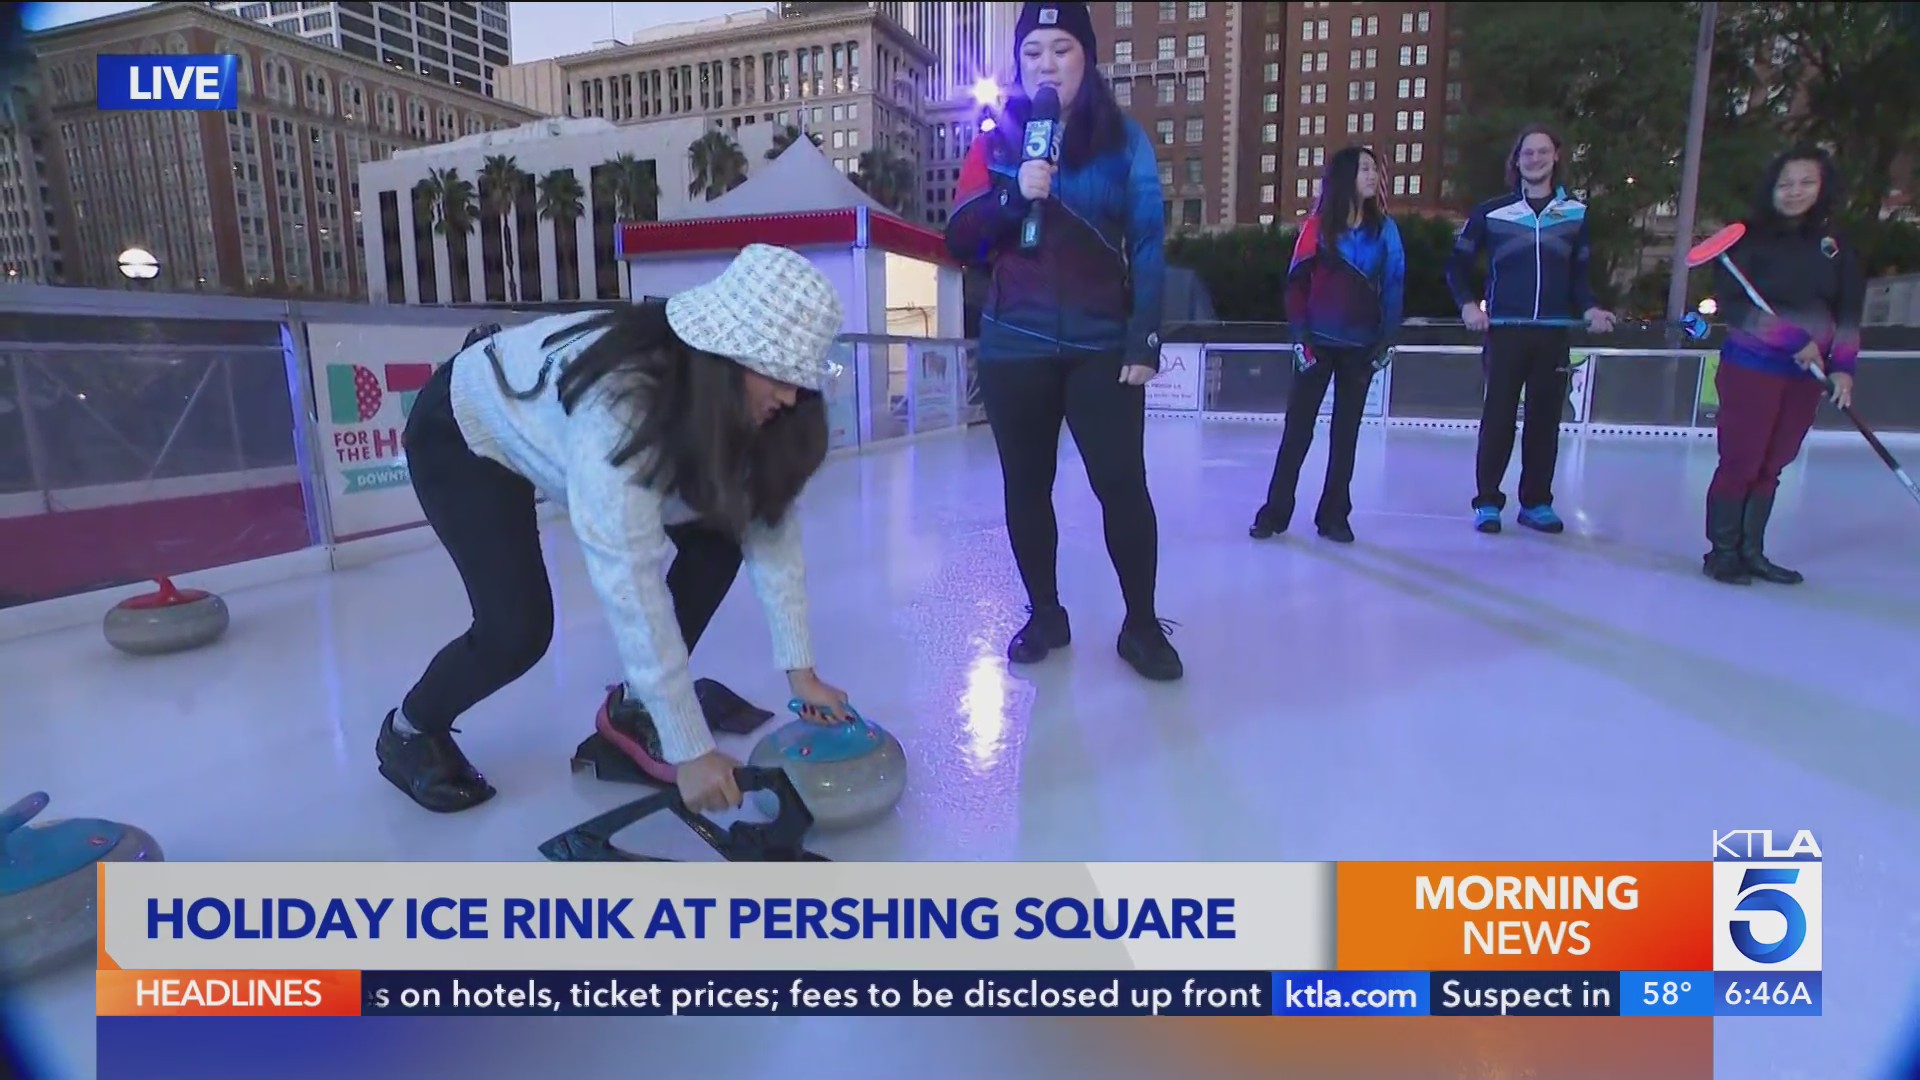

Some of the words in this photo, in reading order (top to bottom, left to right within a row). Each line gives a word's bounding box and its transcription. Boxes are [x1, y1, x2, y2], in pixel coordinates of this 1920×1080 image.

[1026, 130, 1047, 157] 5
[334, 430, 368, 447] FOR
[336, 446, 371, 463] THE
